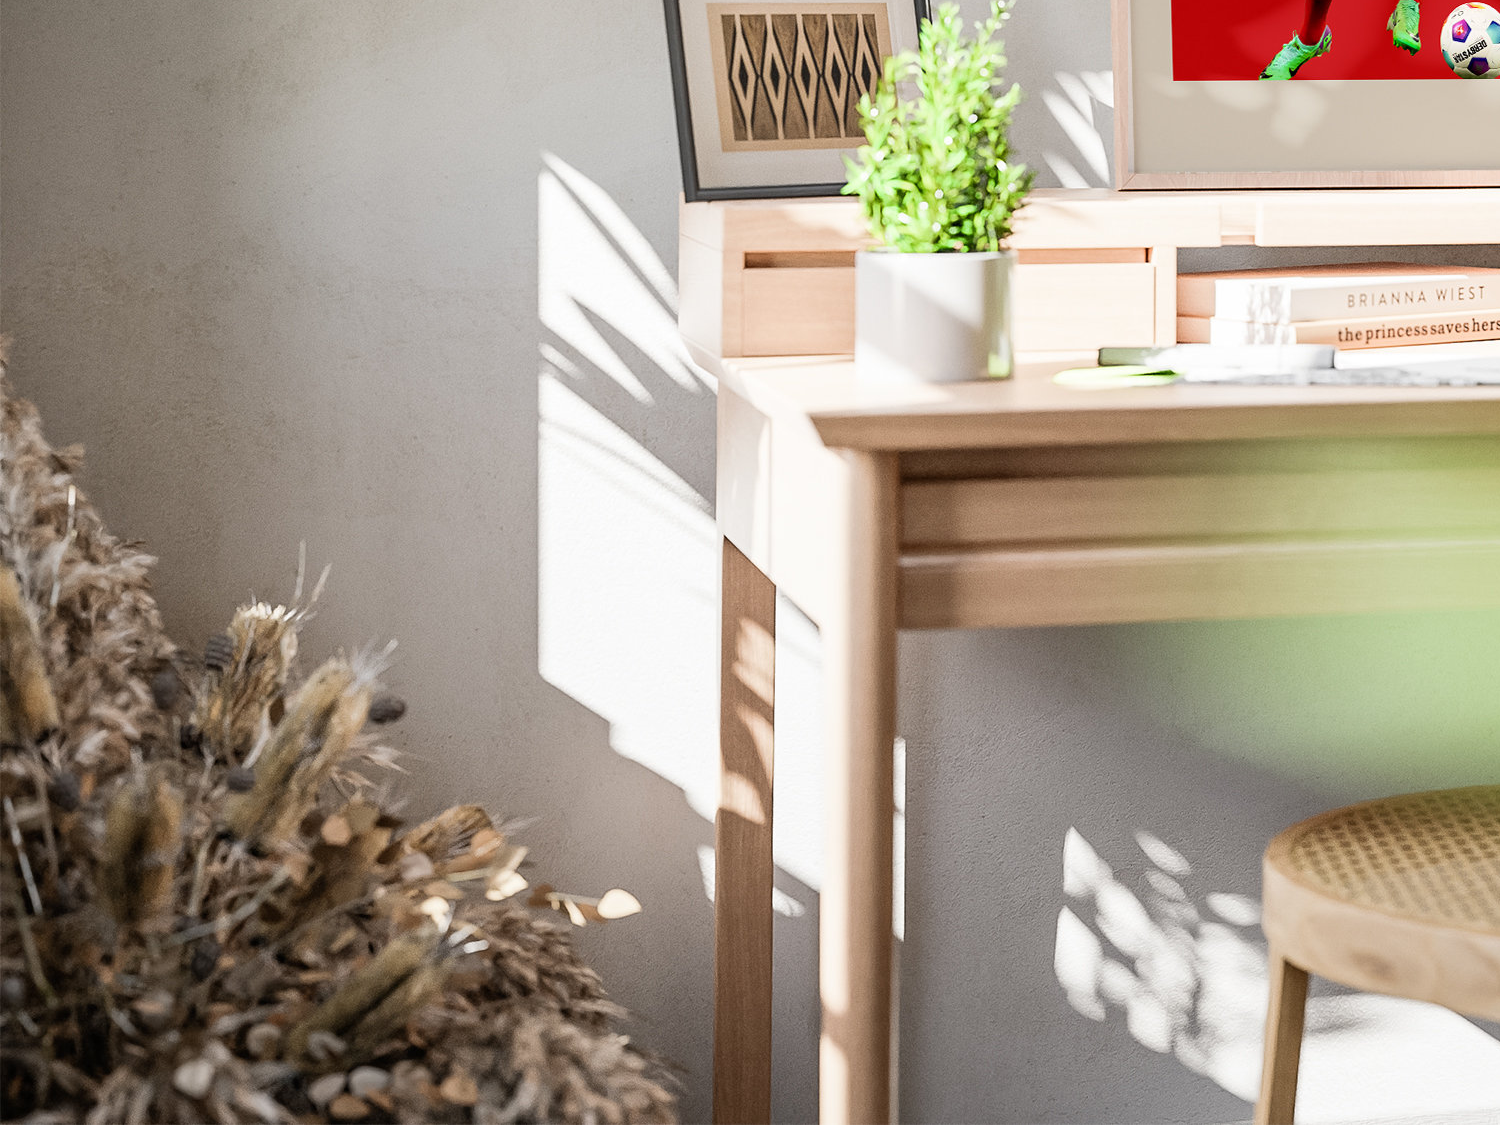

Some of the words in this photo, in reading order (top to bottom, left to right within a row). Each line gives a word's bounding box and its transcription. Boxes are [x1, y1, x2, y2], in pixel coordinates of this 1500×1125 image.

[1347, 290, 1427, 308] BRIANNA
[1436, 285, 1485, 302] WIEST
[1338, 326, 1363, 342] the
[1365, 323, 1431, 344] princess
[1431, 321, 1470, 336] saves
